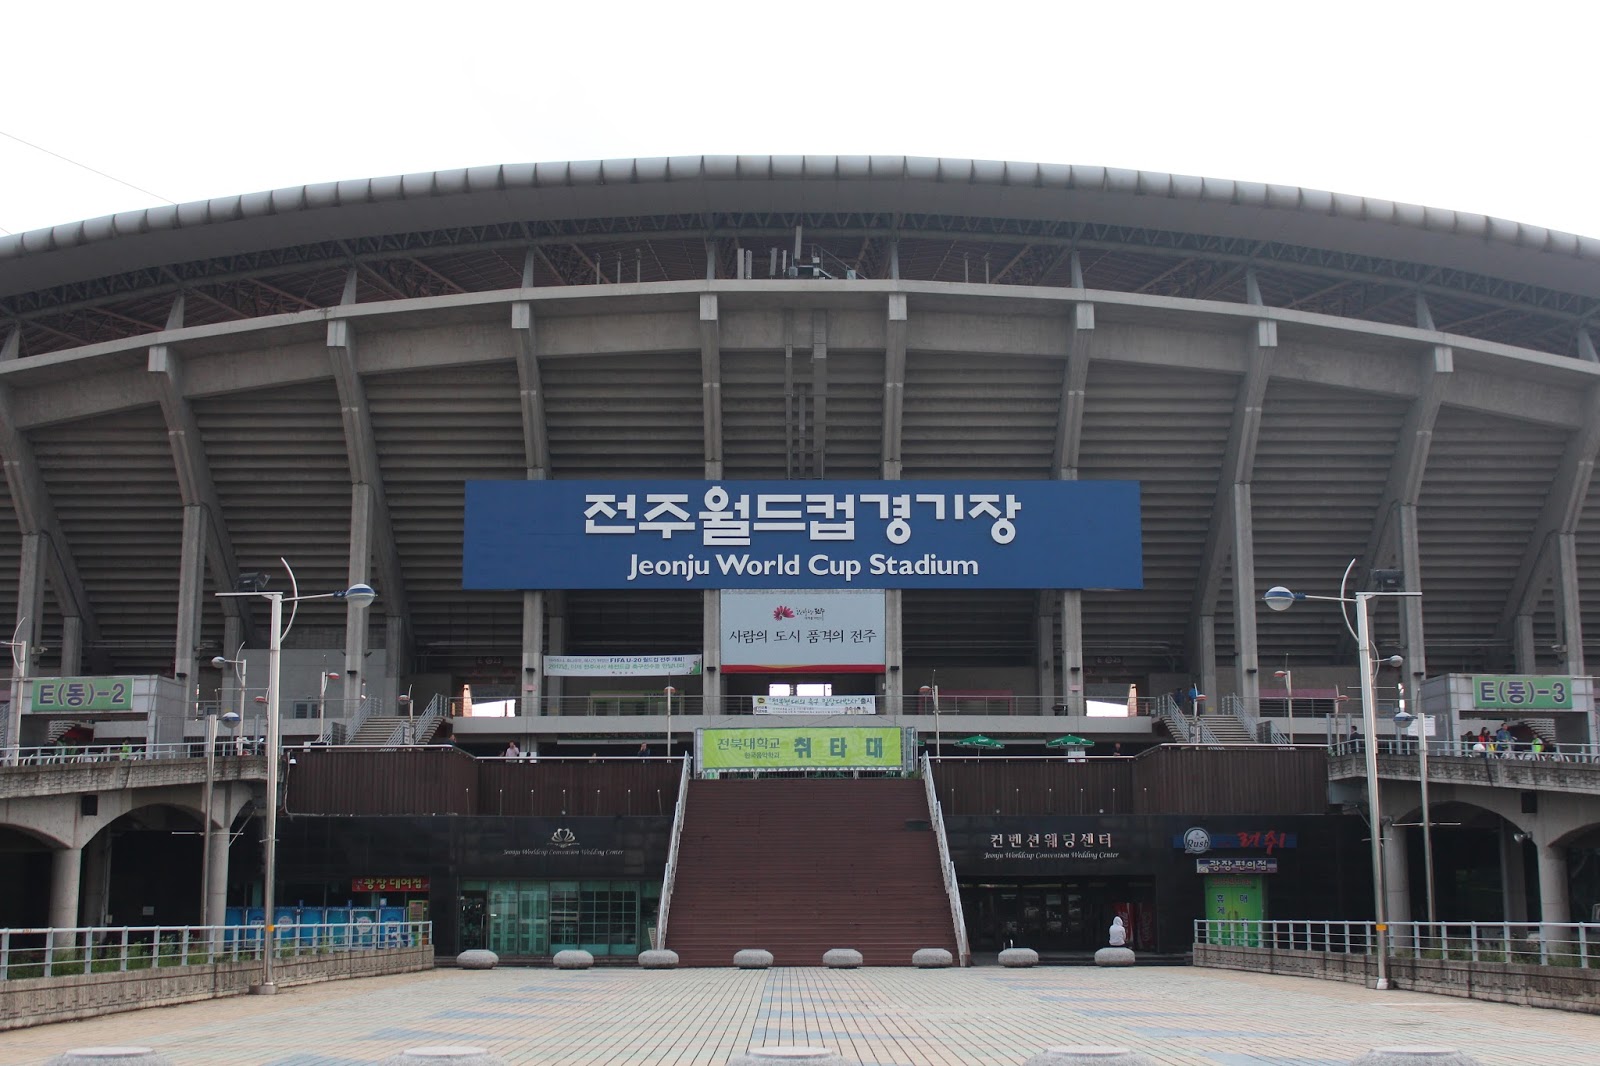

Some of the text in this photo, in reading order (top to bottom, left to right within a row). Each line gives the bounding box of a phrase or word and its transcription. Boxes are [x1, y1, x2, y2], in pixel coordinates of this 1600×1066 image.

[583, 485, 1022, 546] 전주월드컵경기장
[627, 554, 979, 582] Jeonju World Cup Stadium
[728, 630, 876, 644] 사람의 도시 품격의 전주
[40, 683, 125, 706] E(동)-2
[1480, 681, 1566, 704] E(동)-3
[717, 737, 780, 750] 전북대학교
[990, 833, 1111, 848] 컨벤션웨딩센터
[1186, 838, 1210, 848] Rush
[1237, 830, 1287, 856] 러쉬
[984, 852, 1004, 860] Jeonju
[1071, 851, 1098, 859] Wedding
[1209, 860, 1266, 871] 광장 편의점
[363, 878, 387, 890] 광장
[390, 878, 422, 890] 대여점
